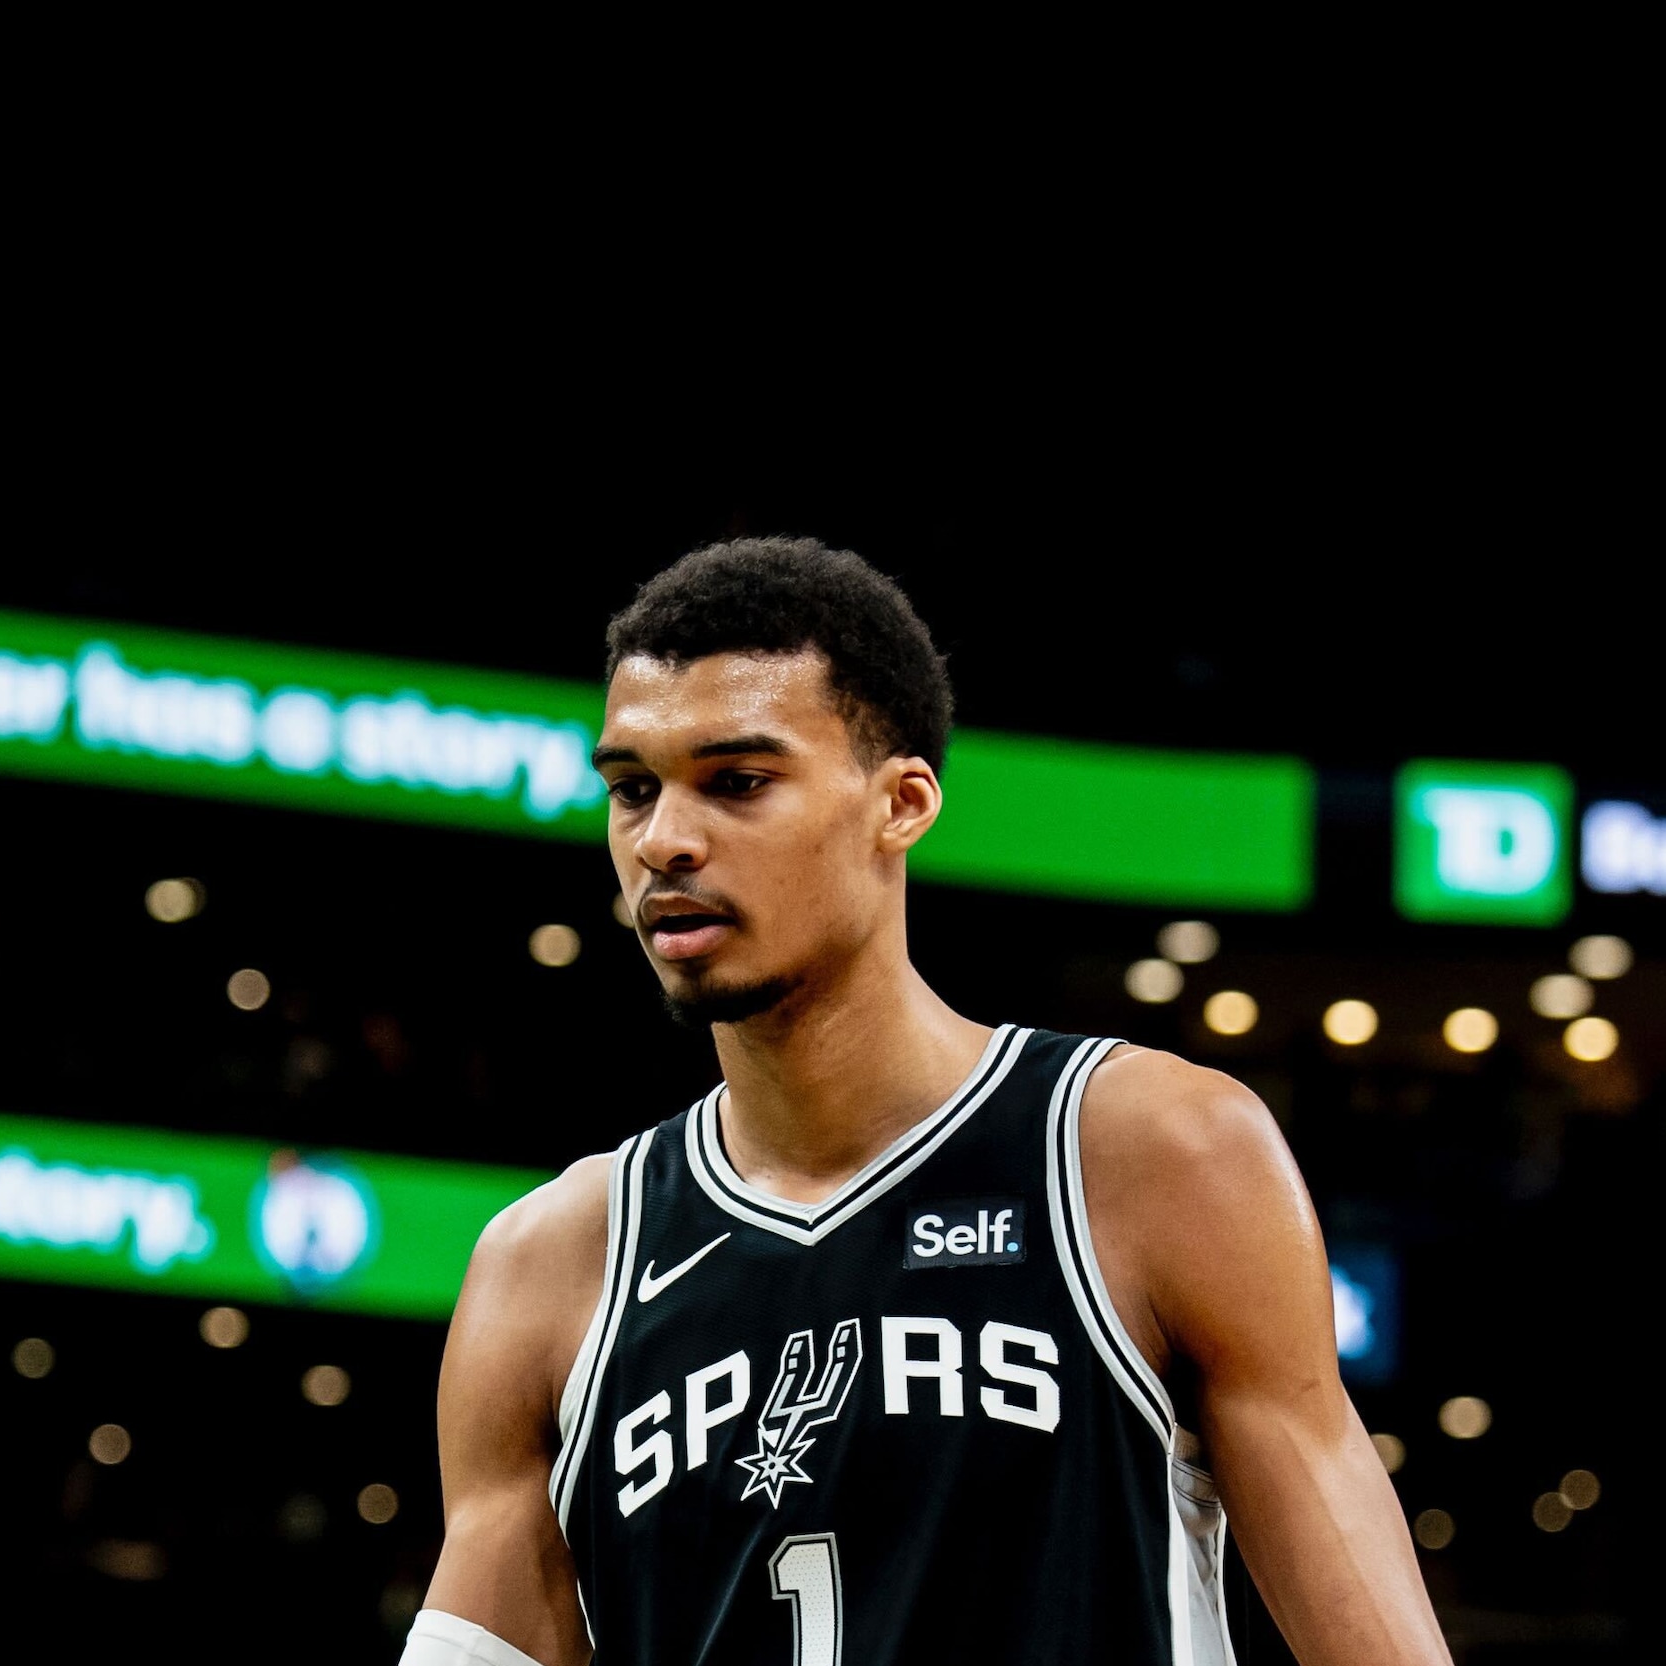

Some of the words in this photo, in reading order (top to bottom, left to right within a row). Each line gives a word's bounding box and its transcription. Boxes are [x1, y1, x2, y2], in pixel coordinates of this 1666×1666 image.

[73, 636, 254, 767] has
[256, 684, 334, 776] a
[1423, 786, 1559, 896] TD
[912, 1209, 1019, 1258] Self.
